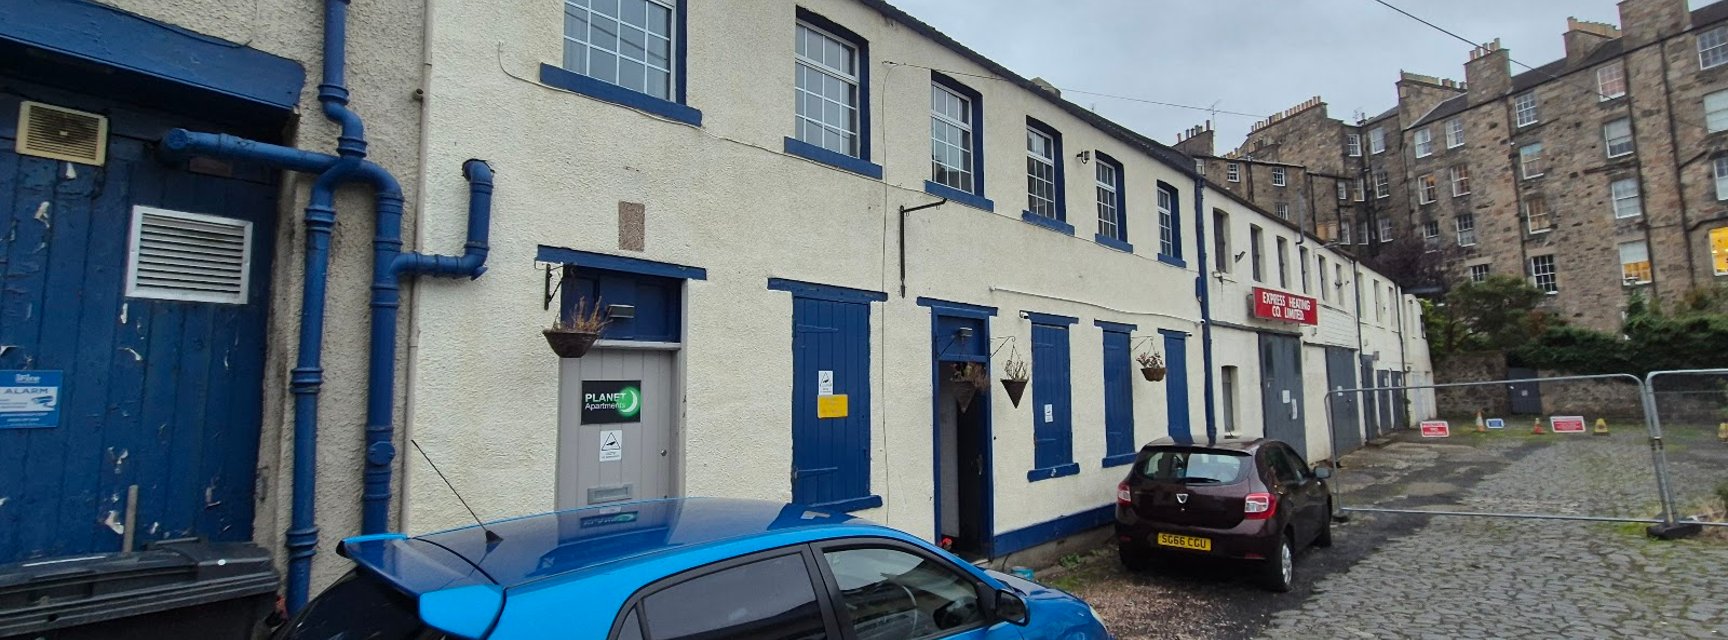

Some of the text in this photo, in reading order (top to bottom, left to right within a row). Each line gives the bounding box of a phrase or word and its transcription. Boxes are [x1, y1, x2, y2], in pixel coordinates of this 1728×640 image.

[1262, 291, 1311, 311] EXPRESS HEATING
[585, 392, 626, 402] PLANET
[584, 402, 626, 411] Apartments
[1161, 534, 1206, 549] SG66 CGU
